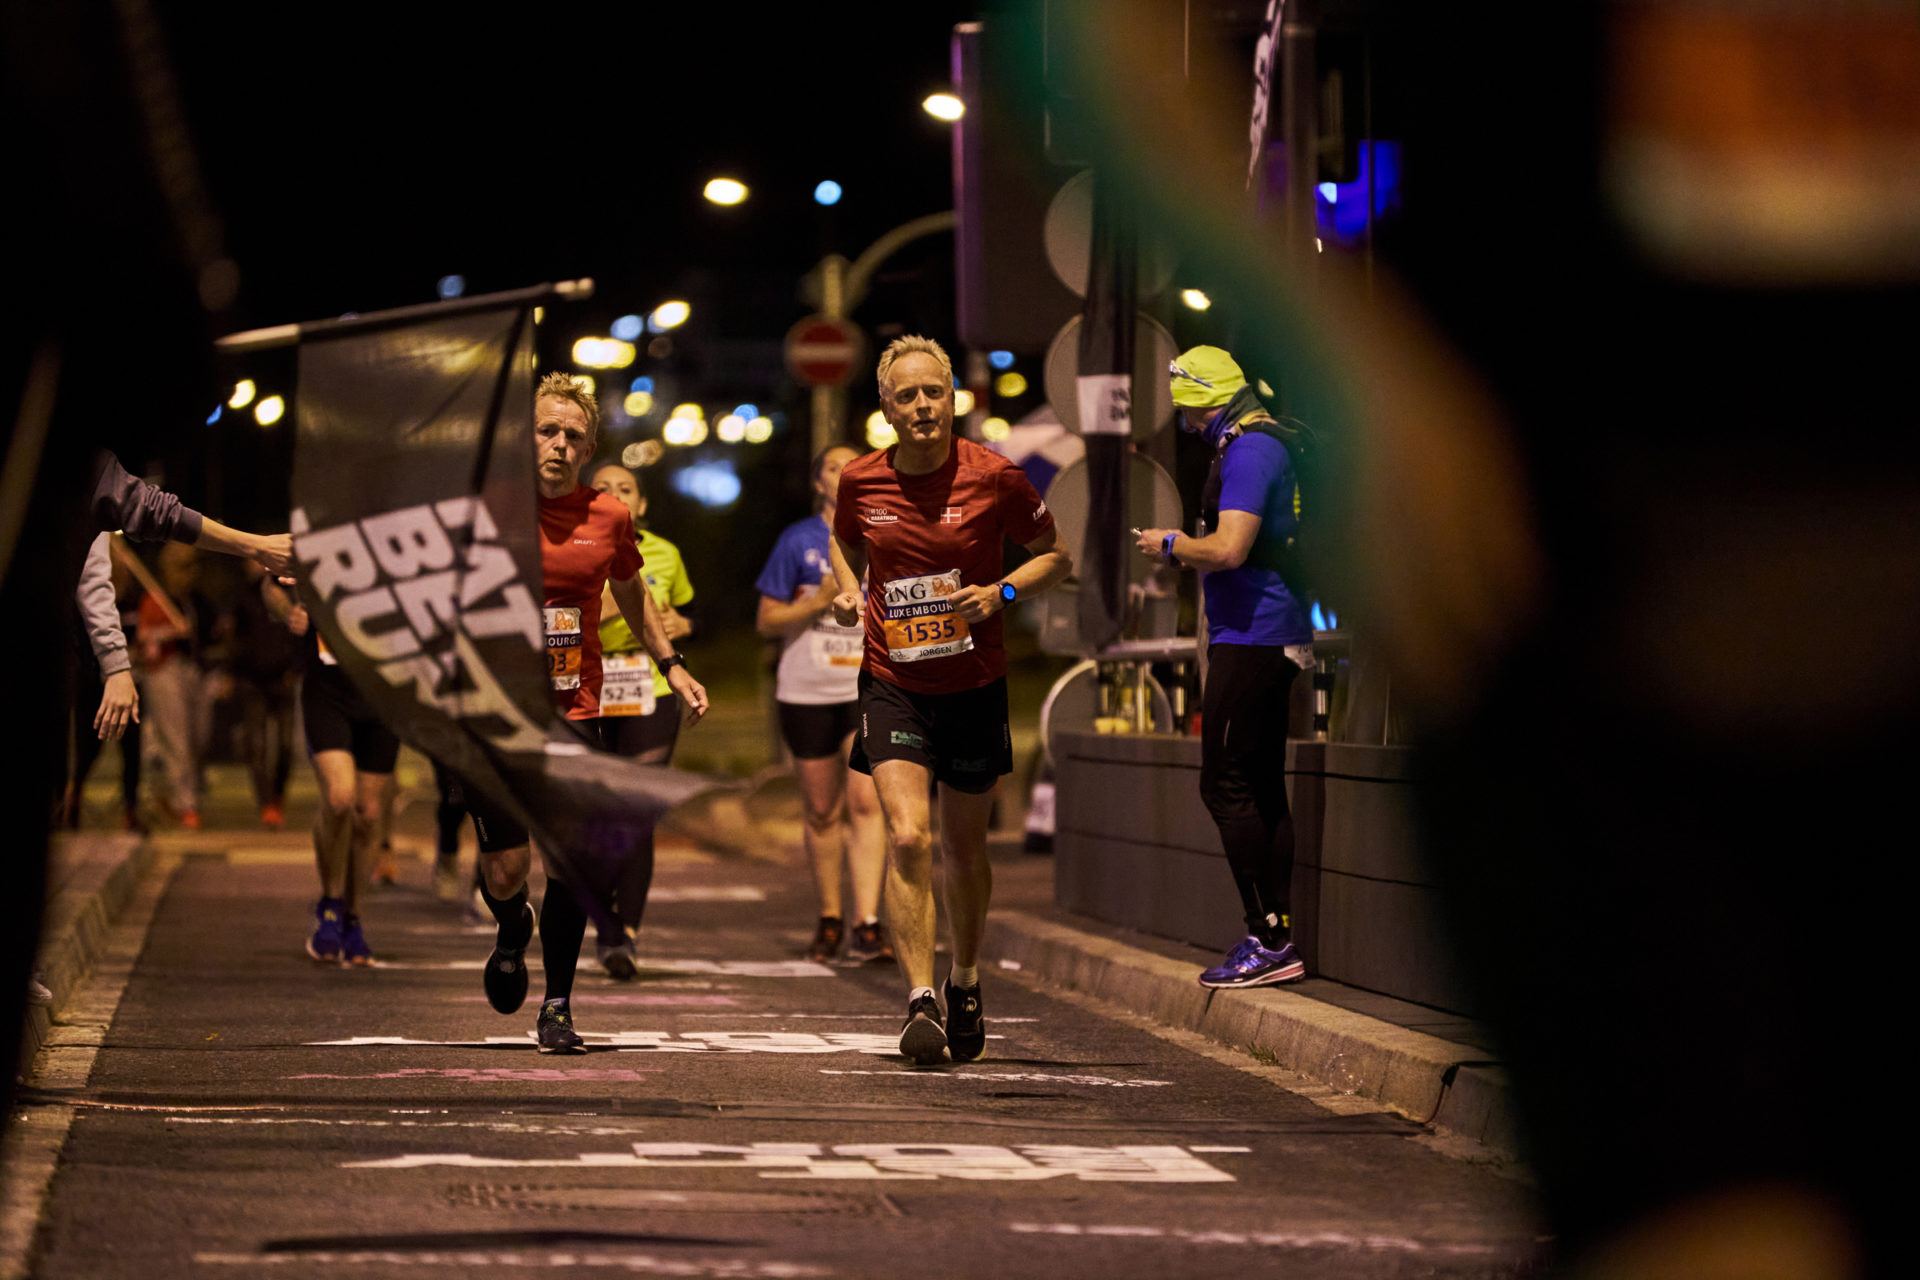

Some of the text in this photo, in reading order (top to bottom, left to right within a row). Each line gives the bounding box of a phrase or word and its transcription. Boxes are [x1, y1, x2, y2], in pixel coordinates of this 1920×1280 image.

[903, 619, 956, 643] 1535
[547, 636, 576, 647] OURG
[919, 645, 952, 657] JØRGEN
